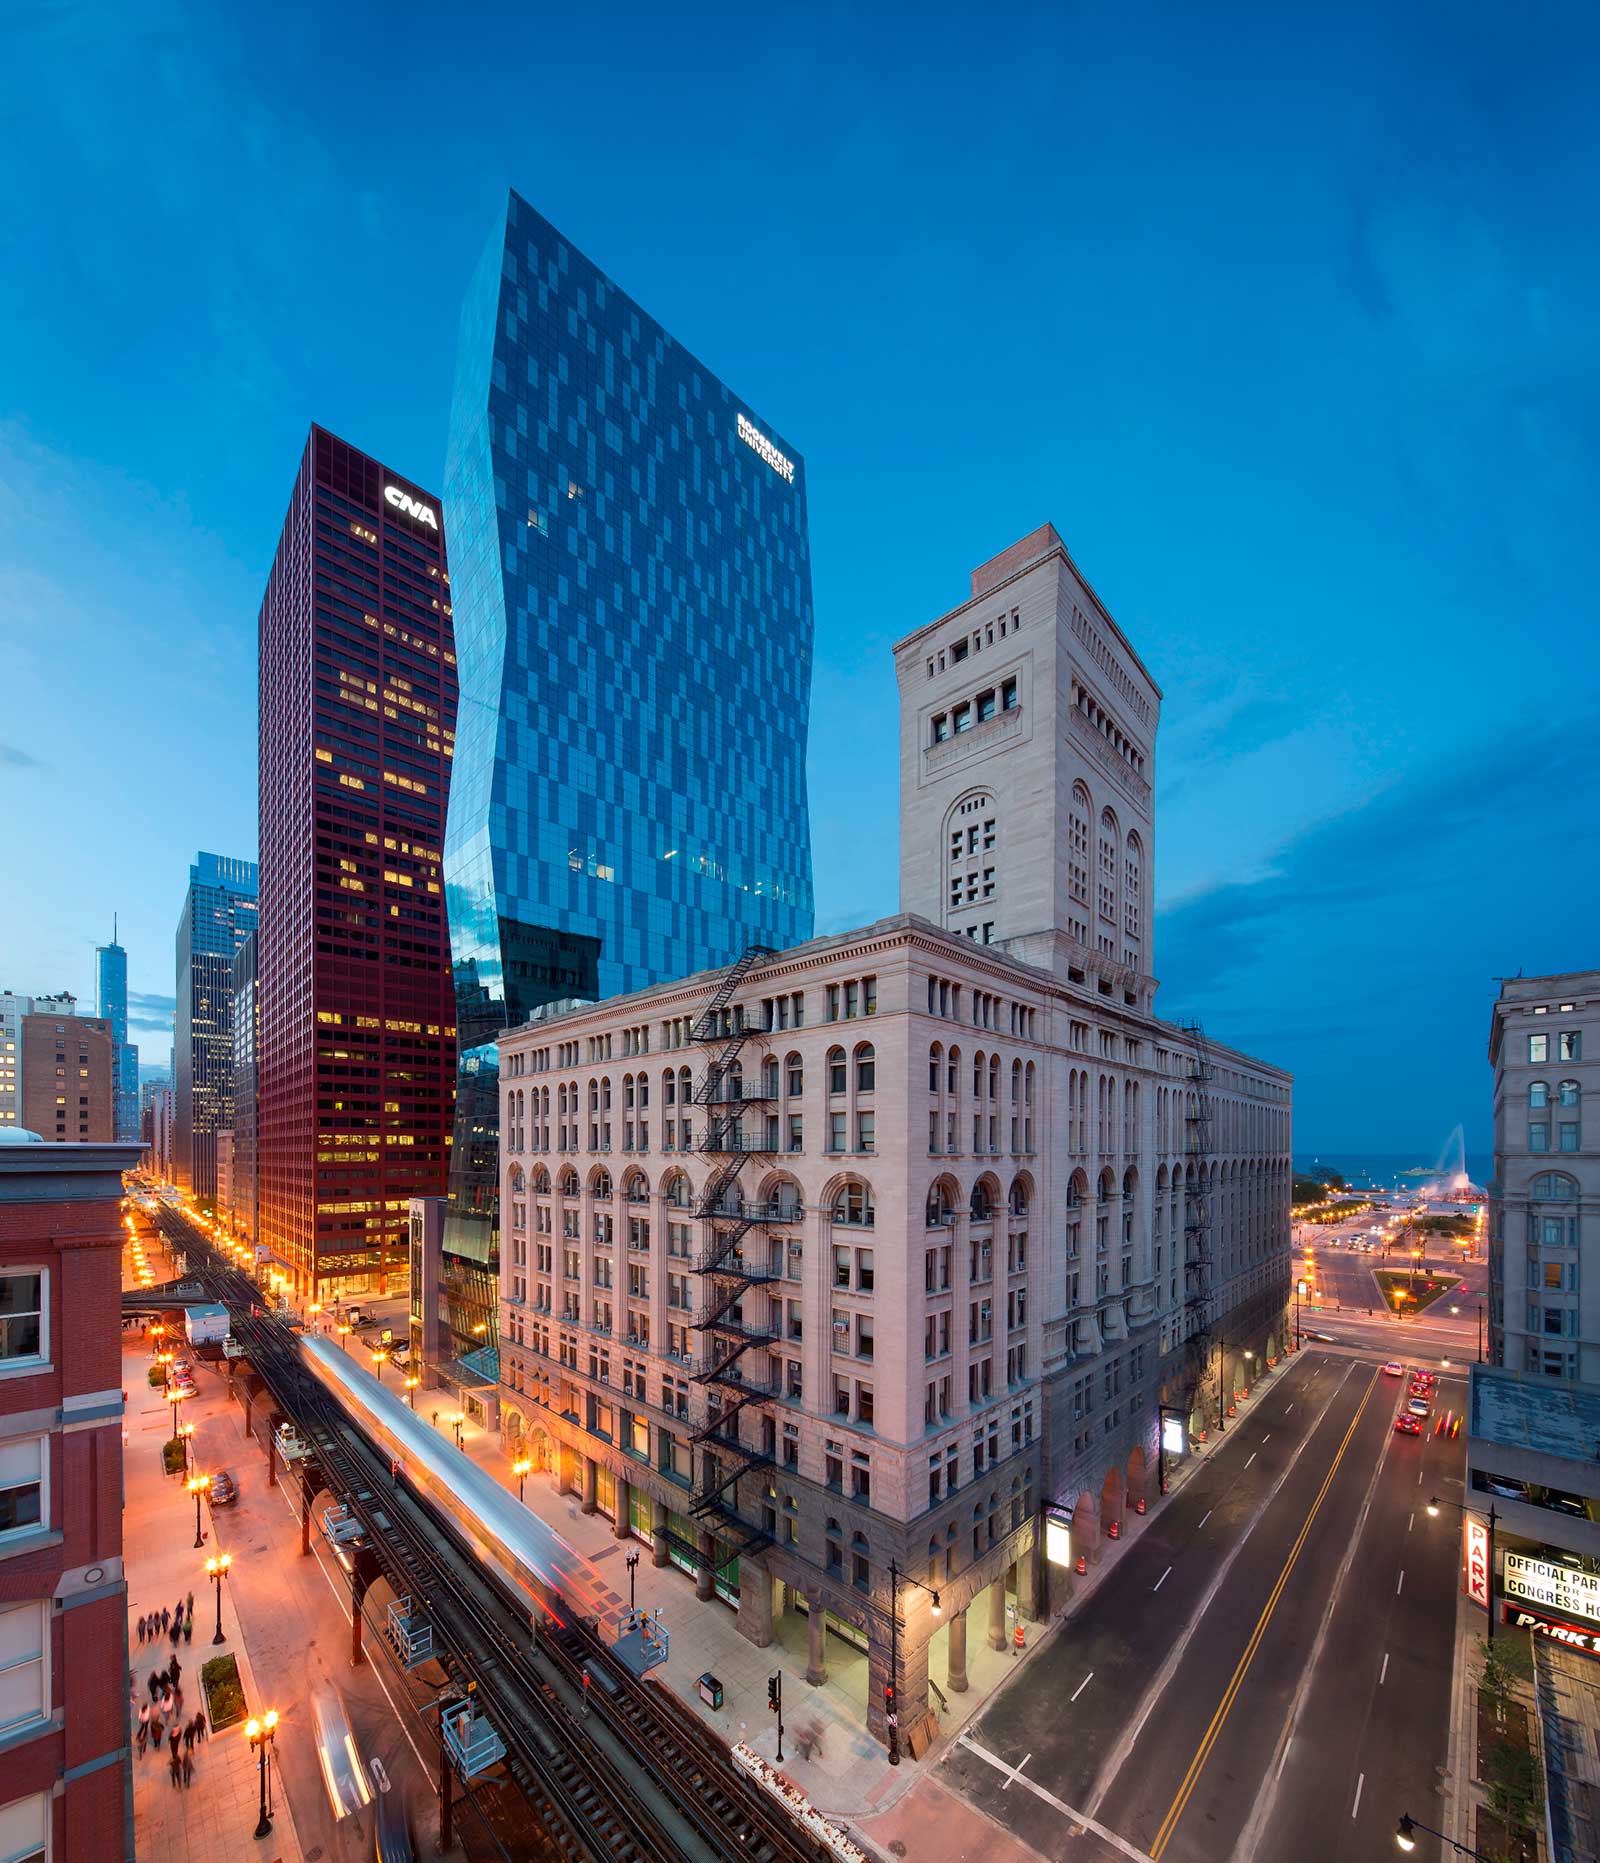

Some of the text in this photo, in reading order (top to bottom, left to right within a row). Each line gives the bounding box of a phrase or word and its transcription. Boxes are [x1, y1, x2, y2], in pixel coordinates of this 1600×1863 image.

[738, 425, 794, 485] UNIVERSITY
[384, 486, 438, 531] CNA
[1472, 1527, 1485, 1599] PARK
[1508, 1556, 1567, 1582] OFFICIAL
[1508, 1580, 1580, 1611] CONGRESS
[1555, 1583, 1580, 1596] FOR
[1516, 1613, 1589, 1647] PARK
